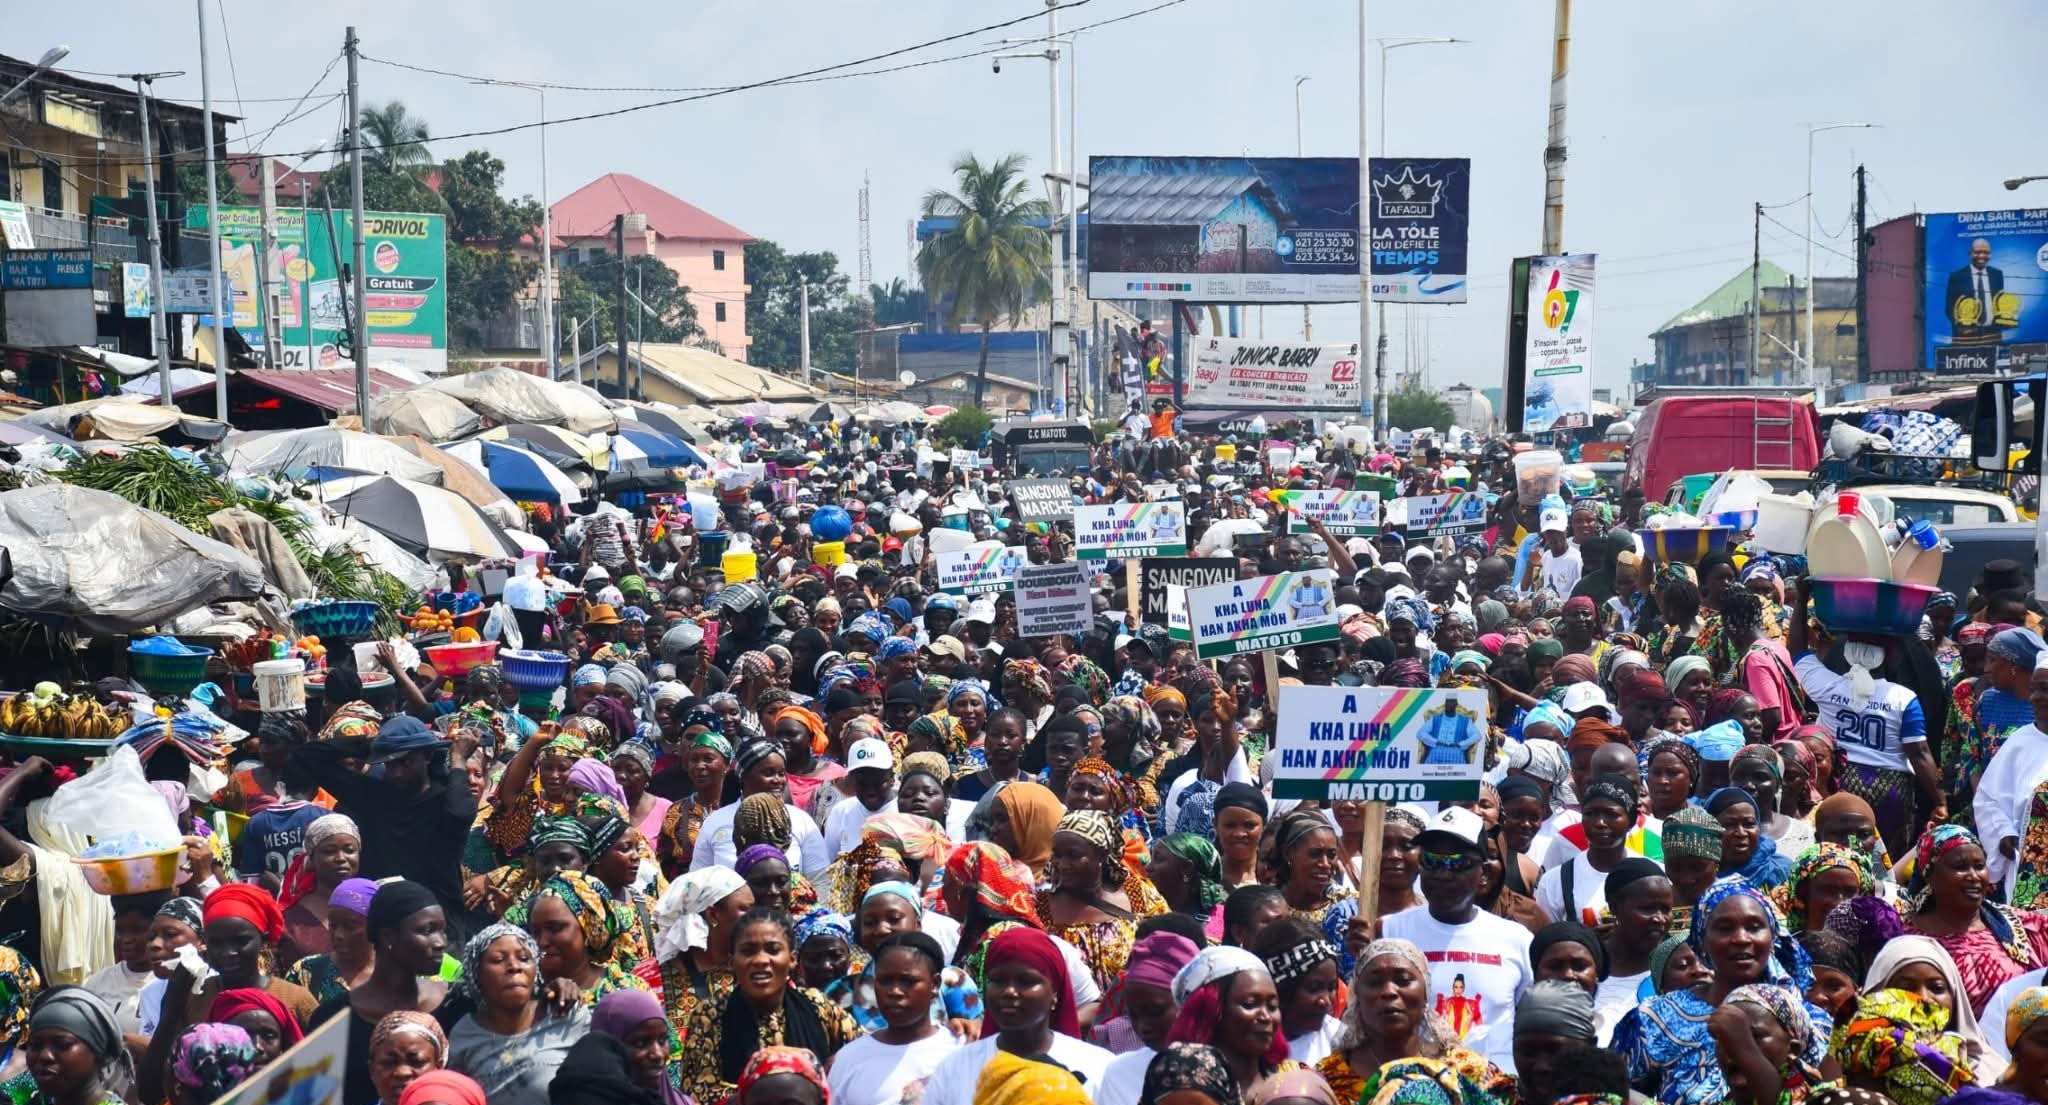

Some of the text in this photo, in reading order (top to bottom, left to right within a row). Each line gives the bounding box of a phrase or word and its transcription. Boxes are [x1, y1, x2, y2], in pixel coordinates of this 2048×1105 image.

[1958, 213, 1985, 223] DINA
[372, 219, 426, 236] DRIVOL
[1372, 221, 1440, 239] LA TÔLE
[1295, 238, 1354, 247] 621 25 30 30
[1372, 239, 1440, 249] QUI DÉFIE LE
[1295, 253, 1355, 261] 623 34 34 34
[1373, 251, 1439, 264] TEMPS
[370, 279, 414, 289] Gratuit
[1230, 345, 1321, 368] JUNIOR BARRY
[1945, 353, 1988, 369] Infinix
[1333, 362, 1355, 379] 22
[1040, 428, 1067, 439] MATOTO
[1015, 485, 1071, 501] SANGOYAH
[1020, 500, 1074, 517] MARCHE
[1107, 507, 1115, 516] A
[1092, 519, 1136, 530] KHA LUNA
[1428, 526, 1466, 536] MATOTO
[1080, 534, 1098, 544] HAN
[1100, 532, 1125, 543] AKHA
[964, 553, 971, 561] A
[1105, 547, 1158, 558] MATOTO
[951, 565, 967, 573] KHA
[1148, 567, 1236, 590] SANGOYAH
[964, 583, 1007, 594] MATOTO
[1233, 585, 1243, 598] A
[1214, 598, 1271, 618] KHA LUNA
[1171, 613, 1187, 625] HAN
[1200, 622, 1225, 638] HAN
[1227, 617, 1258, 634] AKHA
[1235, 631, 1302, 652] MATOTO
[1342, 695, 1357, 714] A
[1309, 721, 1392, 741] KHA LUNA
[1836, 708, 1887, 752] 20
[1281, 746, 1411, 769] HAN AKHA MÖH
[1328, 782, 1426, 801] MATOTO
